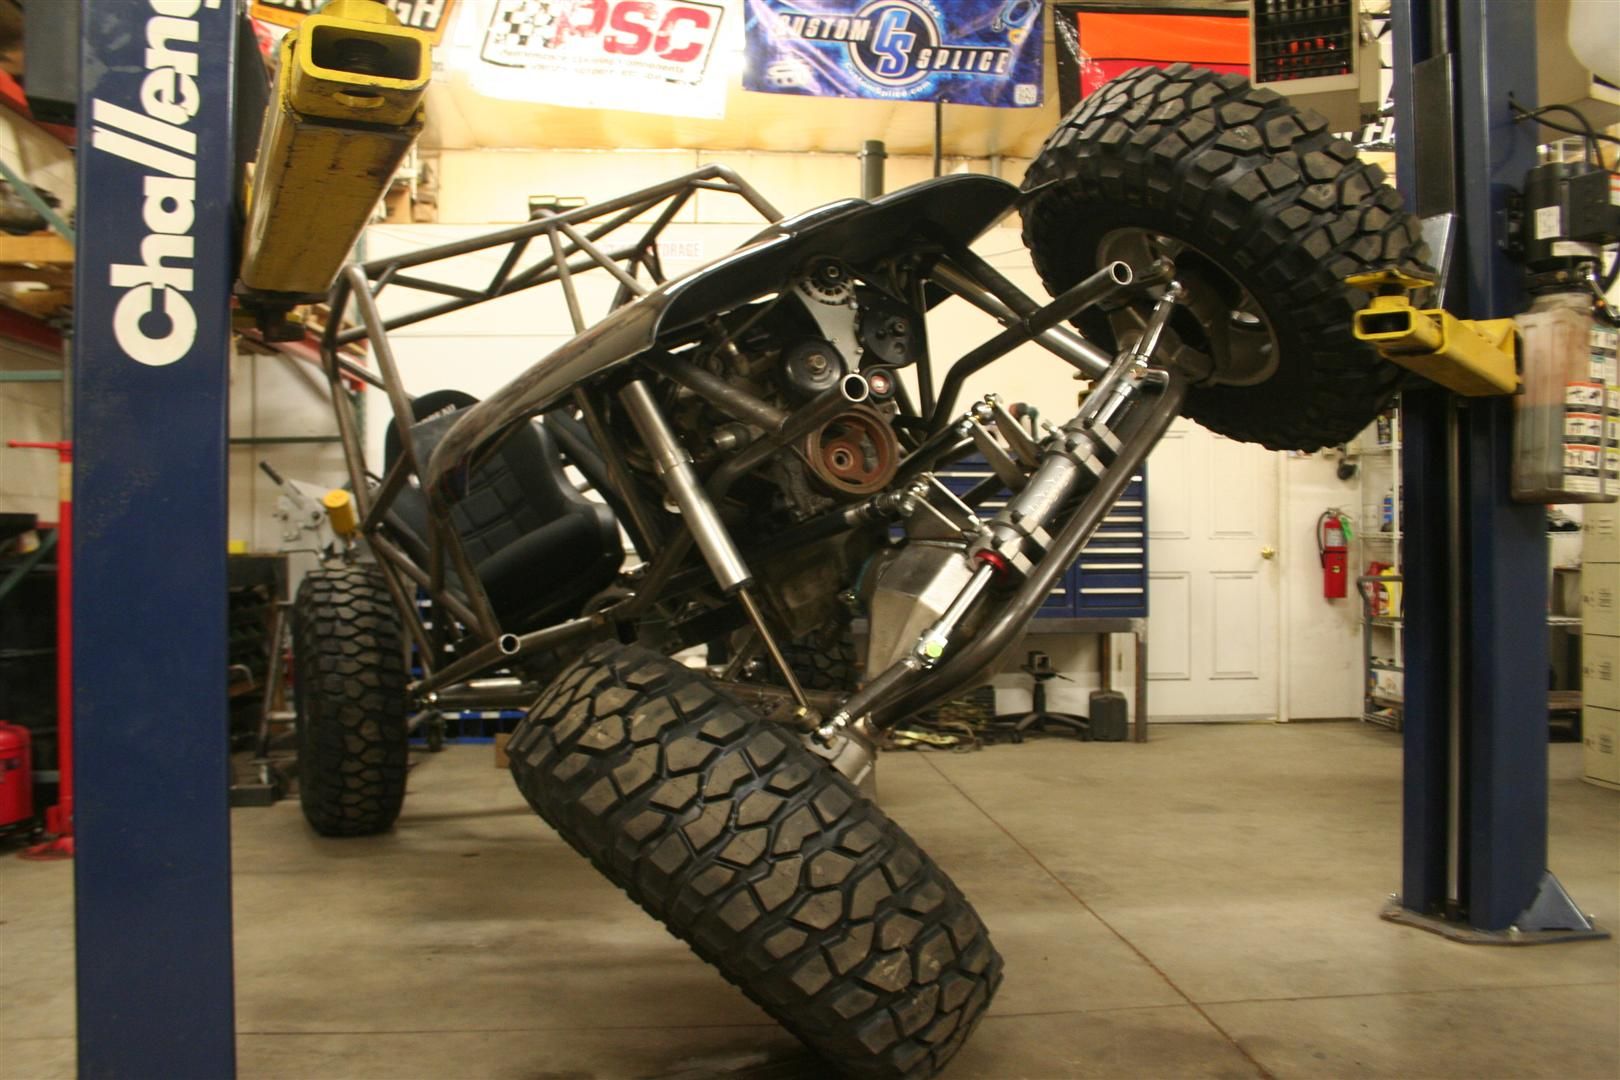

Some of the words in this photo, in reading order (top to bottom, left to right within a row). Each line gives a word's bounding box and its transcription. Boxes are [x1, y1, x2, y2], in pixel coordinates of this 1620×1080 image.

[550, 0, 711, 62] PSC
[916, 48, 1011, 74] SPLICE
[648, 243, 700, 257] ORAGE
